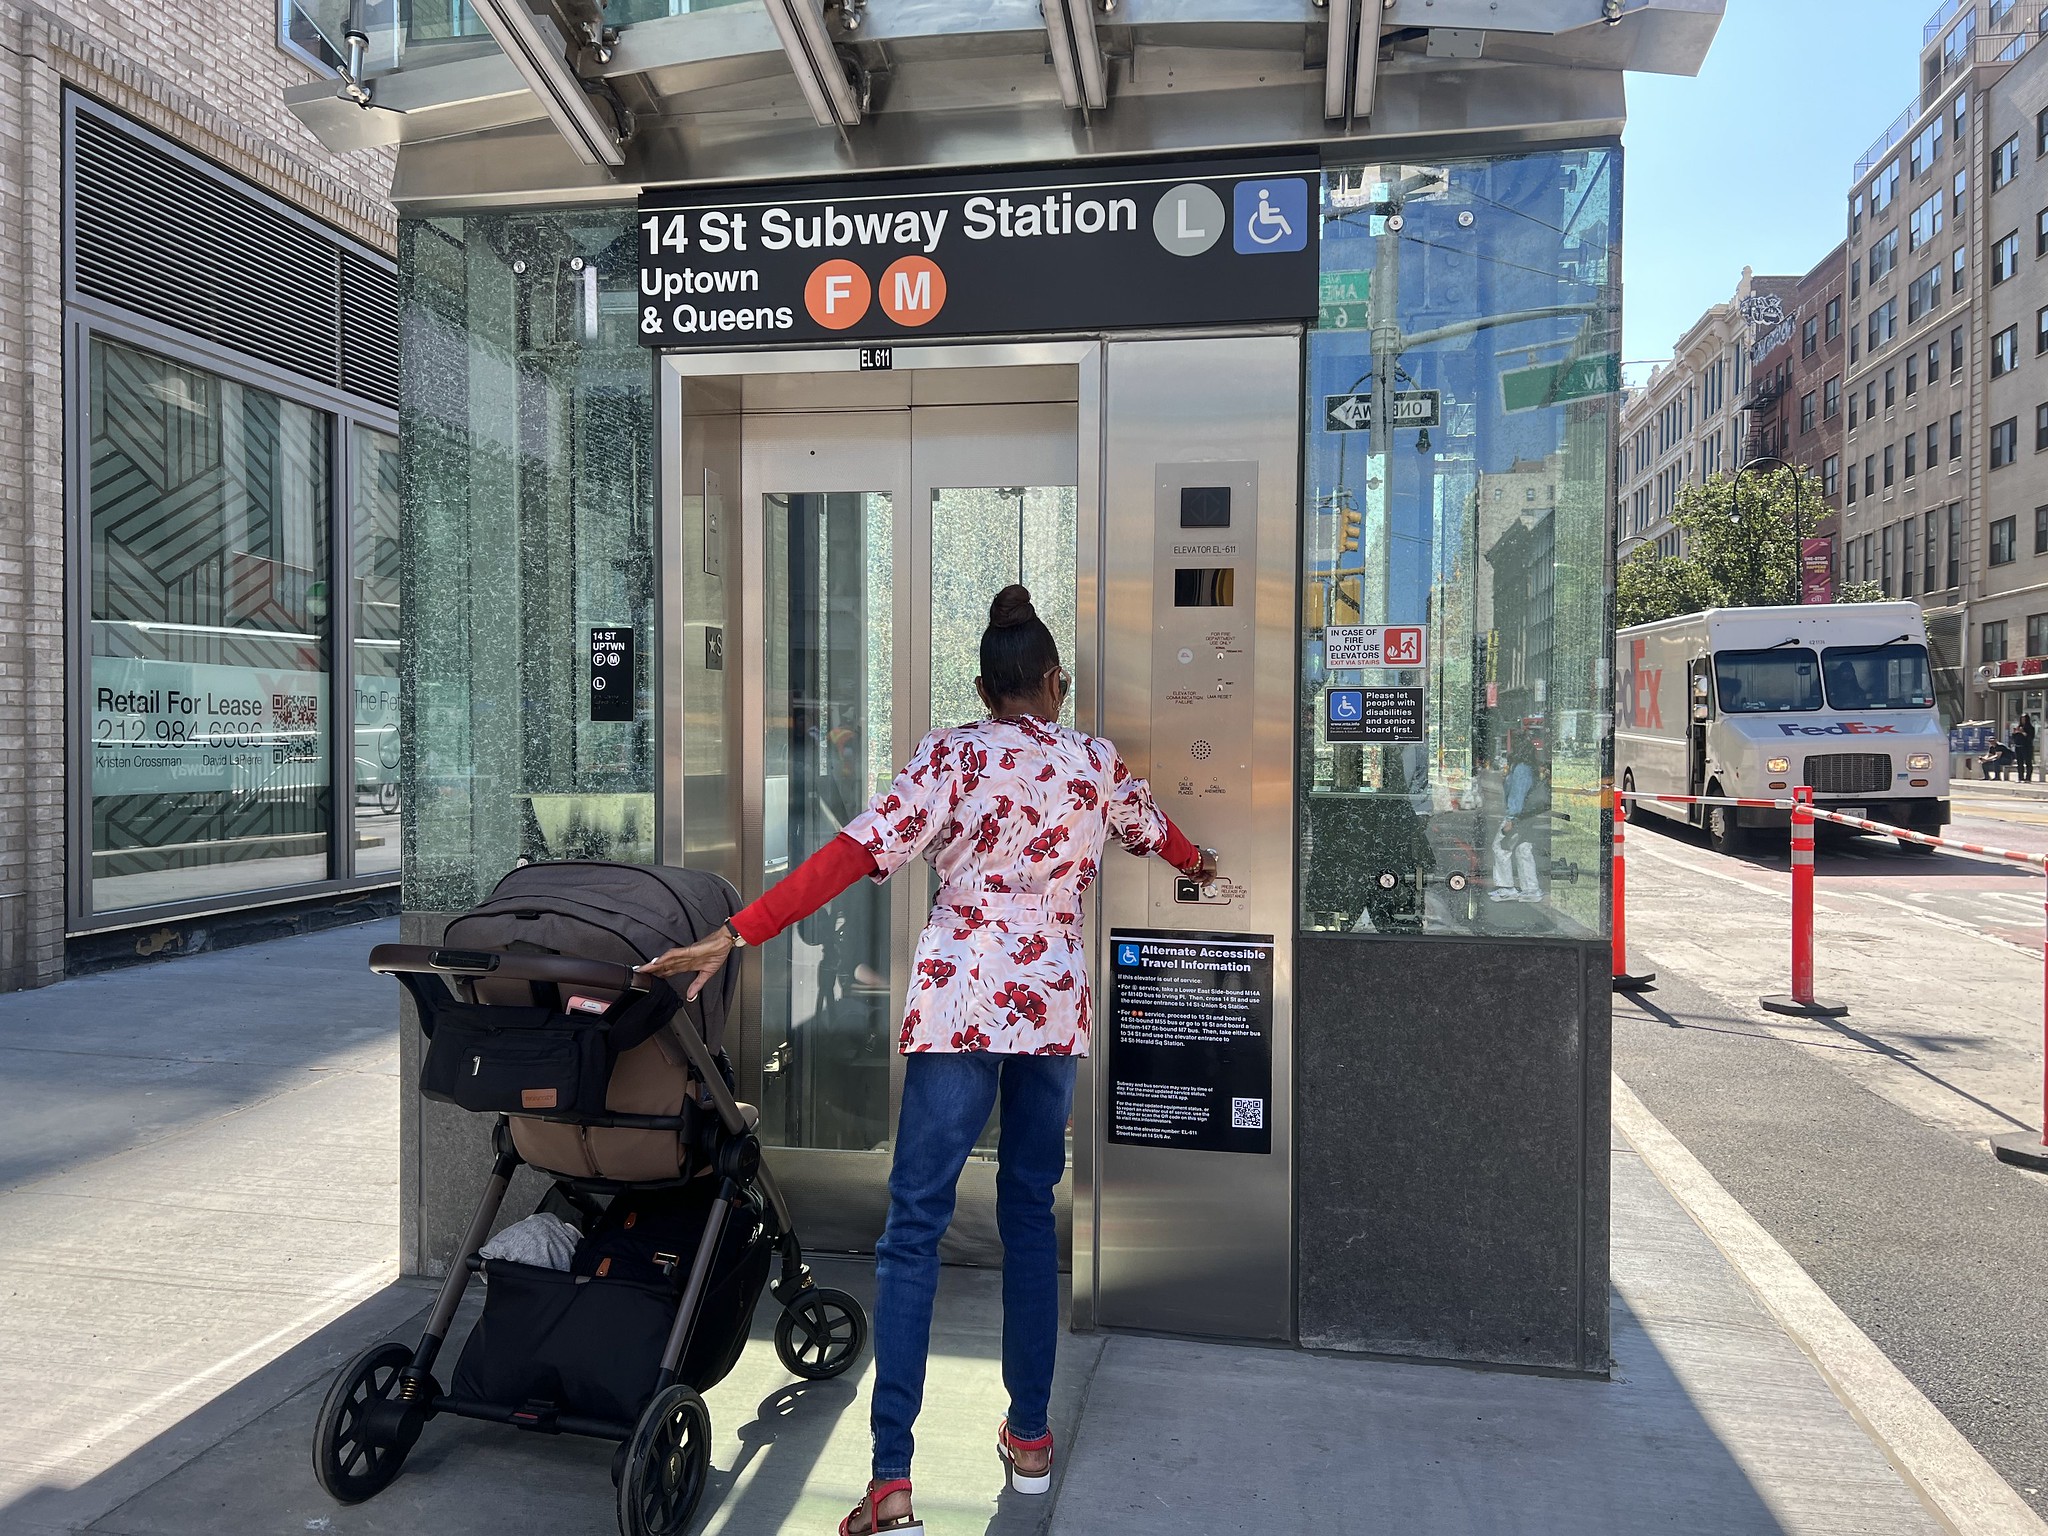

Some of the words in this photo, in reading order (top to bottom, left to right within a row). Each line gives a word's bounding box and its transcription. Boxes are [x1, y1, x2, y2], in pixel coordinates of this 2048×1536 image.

[641, 214, 688, 254] 14
[699, 211, 747, 252] St
[760, 206, 949, 252] Subway
[963, 192, 1137, 240] Station
[1177, 198, 1206, 239] L
[640, 268, 759, 302] Uptown
[825, 275, 853, 314] F
[894, 270, 931, 311] M
[640, 306, 664, 334] &
[672, 304, 793, 333] Queens
[862, 350, 874, 367] EL
[875, 349, 890, 366] 611
[1174, 546, 1212, 554] ELEVATOR
[1212, 546, 1236, 554] EL-611
[593, 632, 603, 640] 14
[604, 632, 616, 640] ST
[593, 642, 625, 650] UPTWN
[1330, 644, 1342, 652] DO
[98, 688, 160, 713] Retail
[168, 691, 201, 714] For
[208, 692, 262, 716] Lease
[354, 690, 376, 710] The
[1366, 700, 1394, 708] people
[1366, 708, 1412, 716] disabilities
[98, 719, 262, 748] 212.984.6686
[1778, 722, 1900, 736] FedEx
[96, 756, 130, 768] Kristen
[134, 756, 182, 768] Crossman
[203, 754, 226, 766] David
[230, 754, 262, 766] LaPierre
[1141, 945, 1196, 956] Alternate
[1200, 948, 1266, 960] Accessible
[1141, 958, 1178, 968] Travel
[1182, 960, 1251, 972] Information
